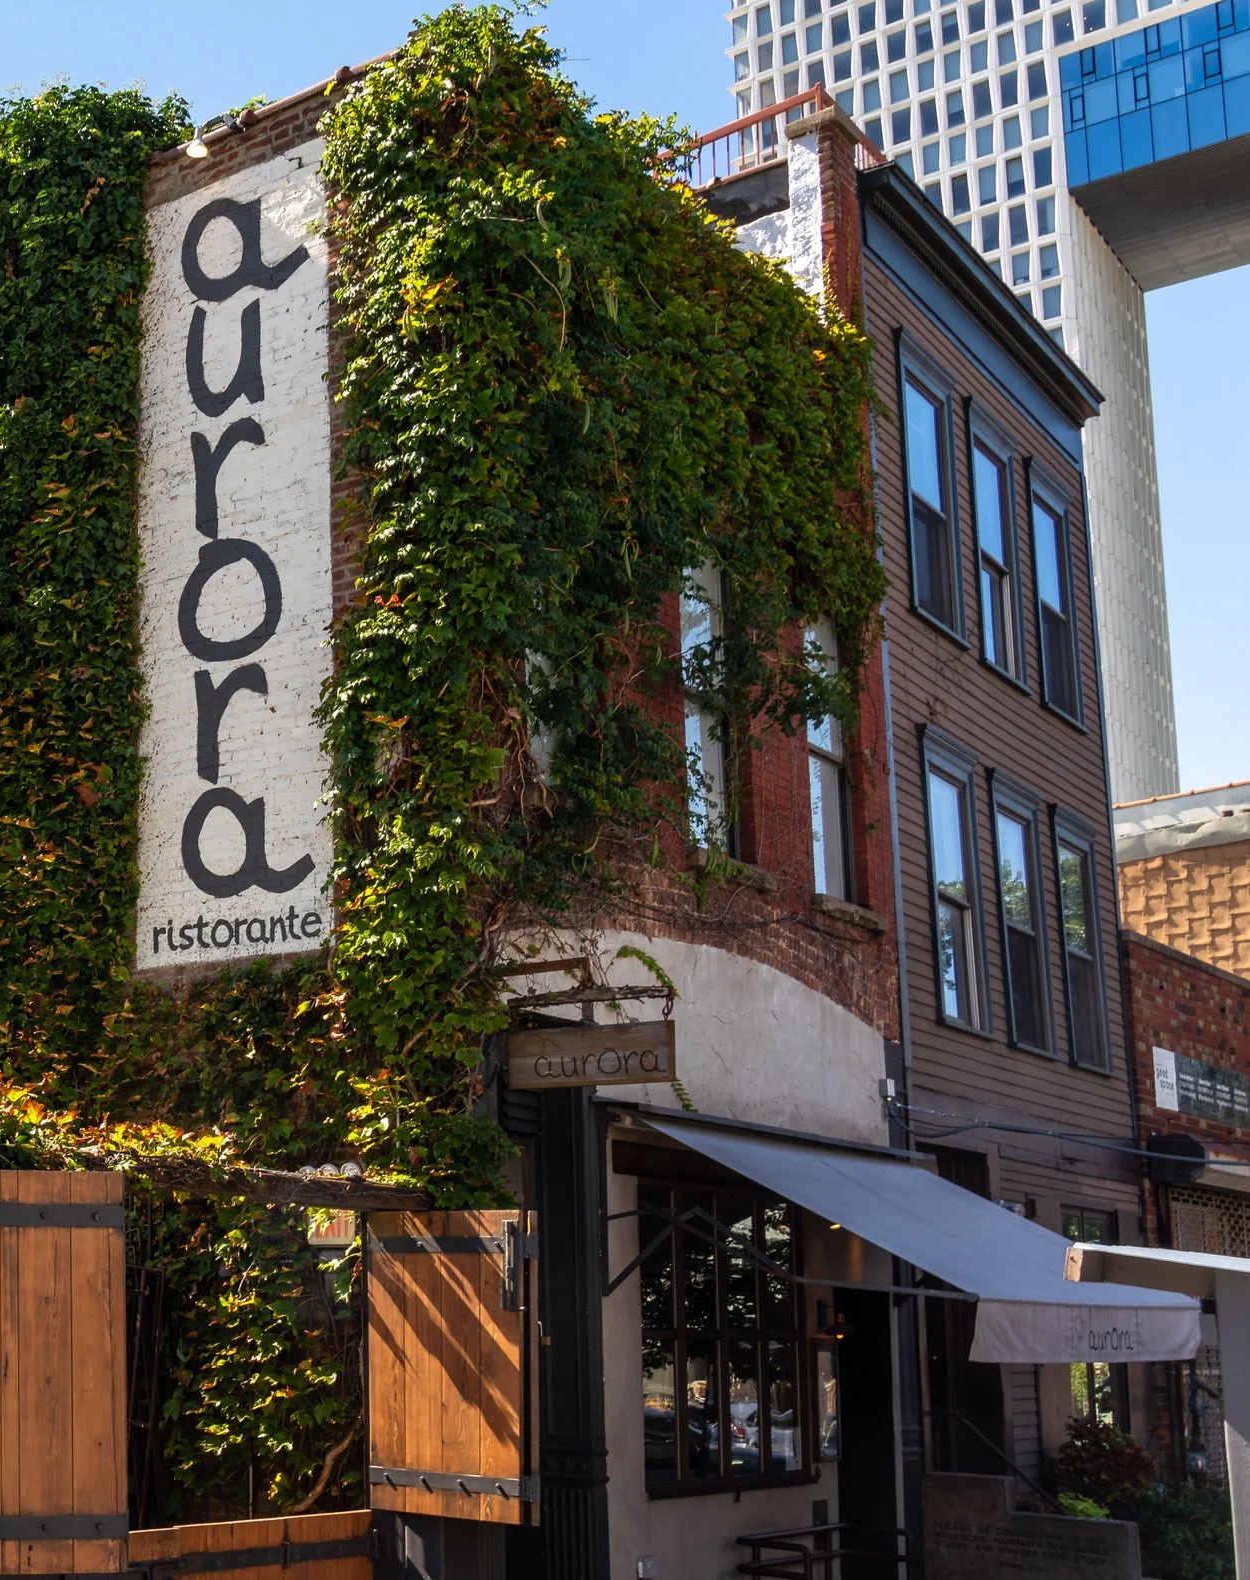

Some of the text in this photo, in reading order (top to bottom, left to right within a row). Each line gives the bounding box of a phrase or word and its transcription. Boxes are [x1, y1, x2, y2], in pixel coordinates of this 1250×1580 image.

[180, 197, 316, 898] aurora
[152, 905, 323, 954] ristorante
[534, 1048, 667, 1078] aurora
[1088, 1326, 1134, 1351] aurora
